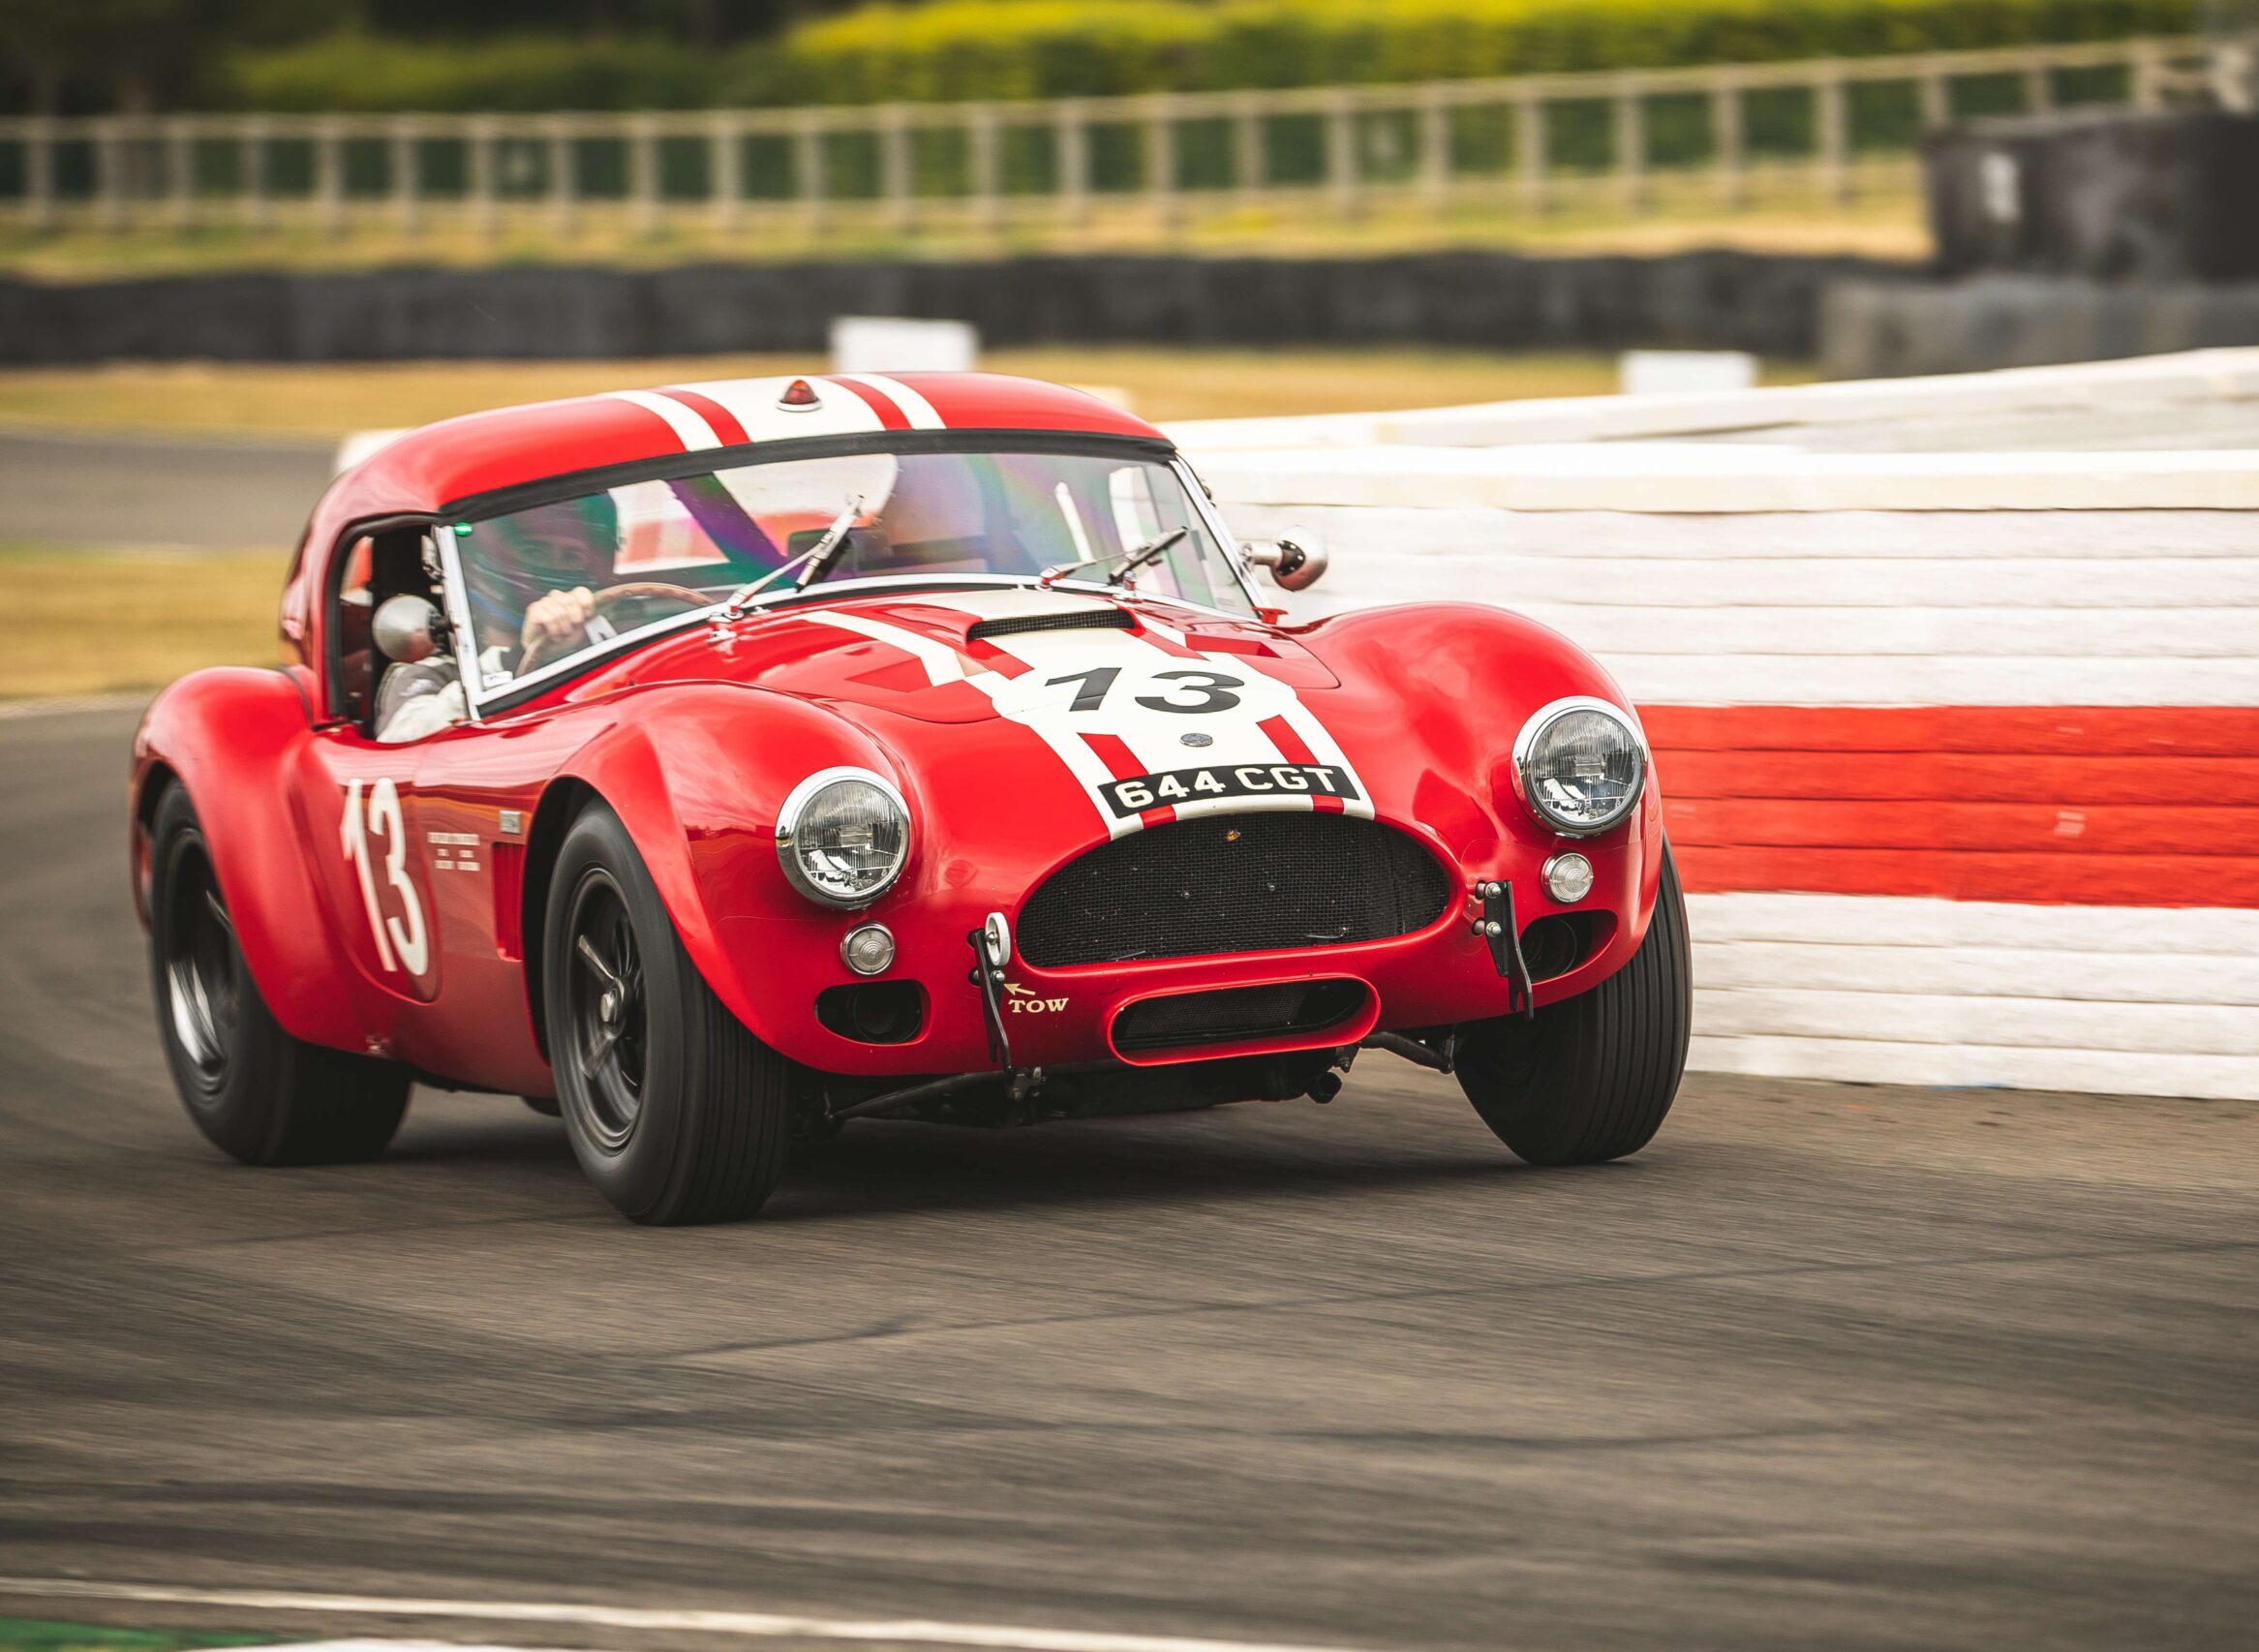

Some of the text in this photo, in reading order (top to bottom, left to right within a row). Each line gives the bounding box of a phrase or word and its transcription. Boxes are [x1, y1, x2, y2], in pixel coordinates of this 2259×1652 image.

[1045, 667, 1245, 714] 13
[1114, 765, 1337, 809] 644 CGT
[339, 778, 429, 976] 13
[1008, 997, 1070, 1014] TOW
